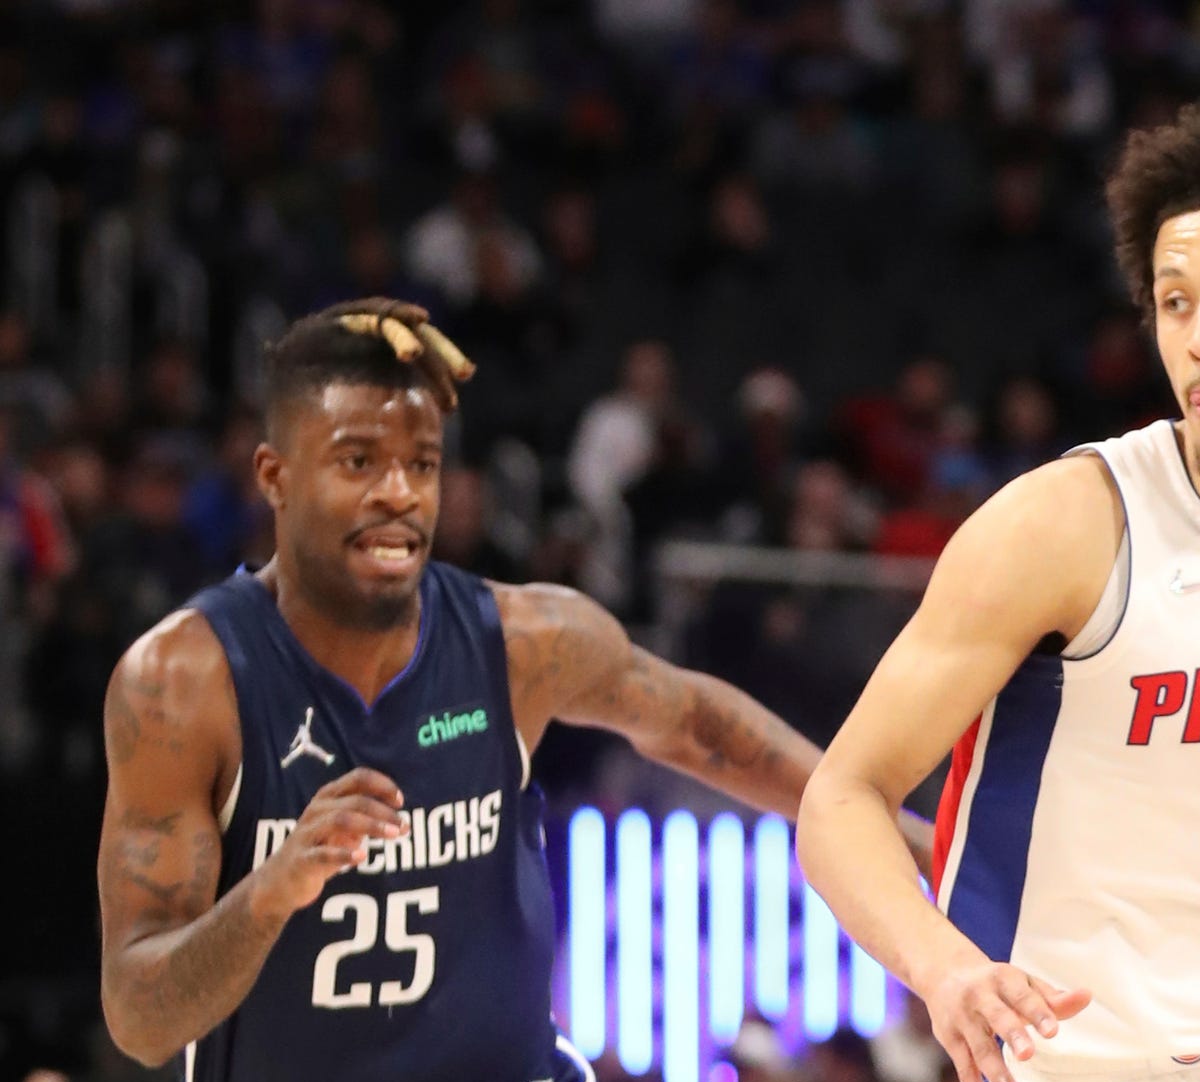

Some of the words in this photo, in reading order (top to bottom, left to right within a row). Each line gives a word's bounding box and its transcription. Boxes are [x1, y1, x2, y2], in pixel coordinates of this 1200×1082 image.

[417, 707, 488, 747] chime
[251, 789, 502, 874] MERICKS
[311, 886, 440, 1009] 25
